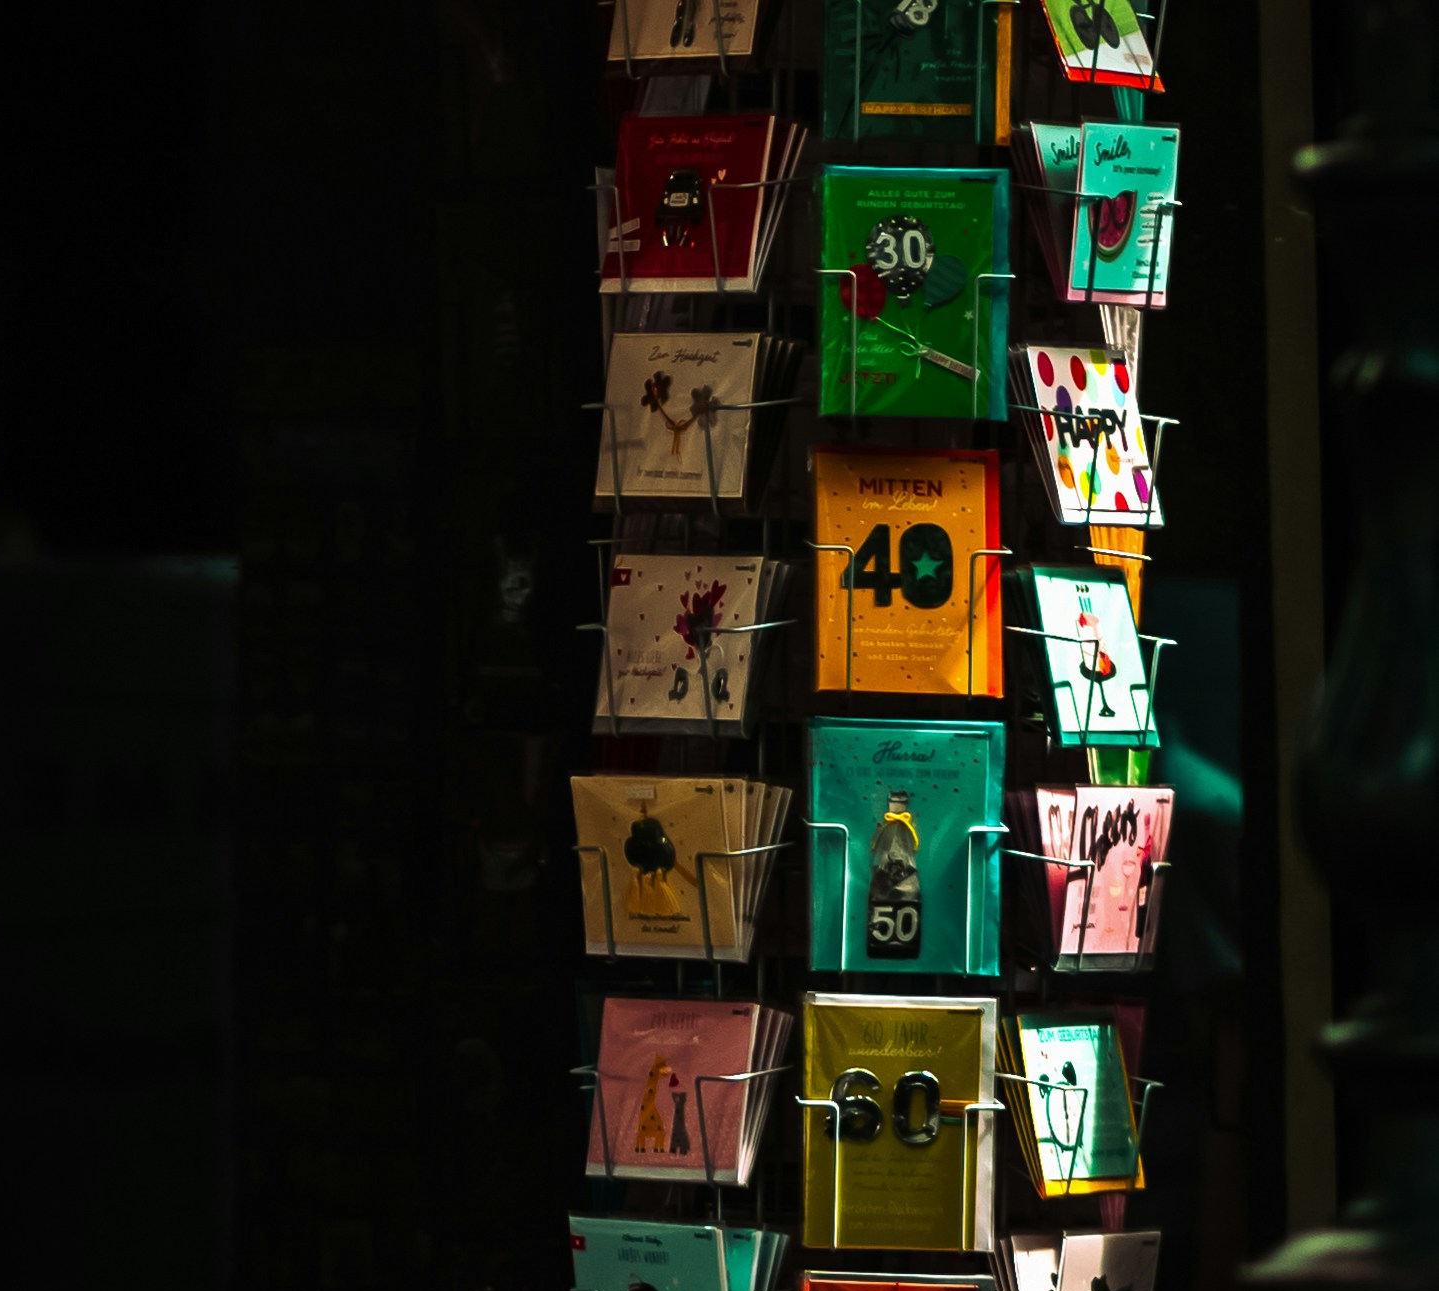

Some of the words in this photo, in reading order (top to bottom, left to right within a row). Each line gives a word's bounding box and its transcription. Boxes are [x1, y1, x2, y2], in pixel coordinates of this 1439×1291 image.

[856, 199, 897, 209] RUNDEN
[867, 189, 901, 198] ALLES
[903, 190, 931, 199] GUTE
[933, 190, 956, 200] ZUM
[875, 229, 927, 270] 30
[858, 478, 943, 497] MITTEN
[841, 522, 954, 610] 40
[872, 739, 936, 764] Hurra!
[870, 905, 920, 942] 50
[862, 1021, 882, 1046] 60
[891, 1021, 930, 1045] JAHR
[827, 1067, 941, 1145] 60
